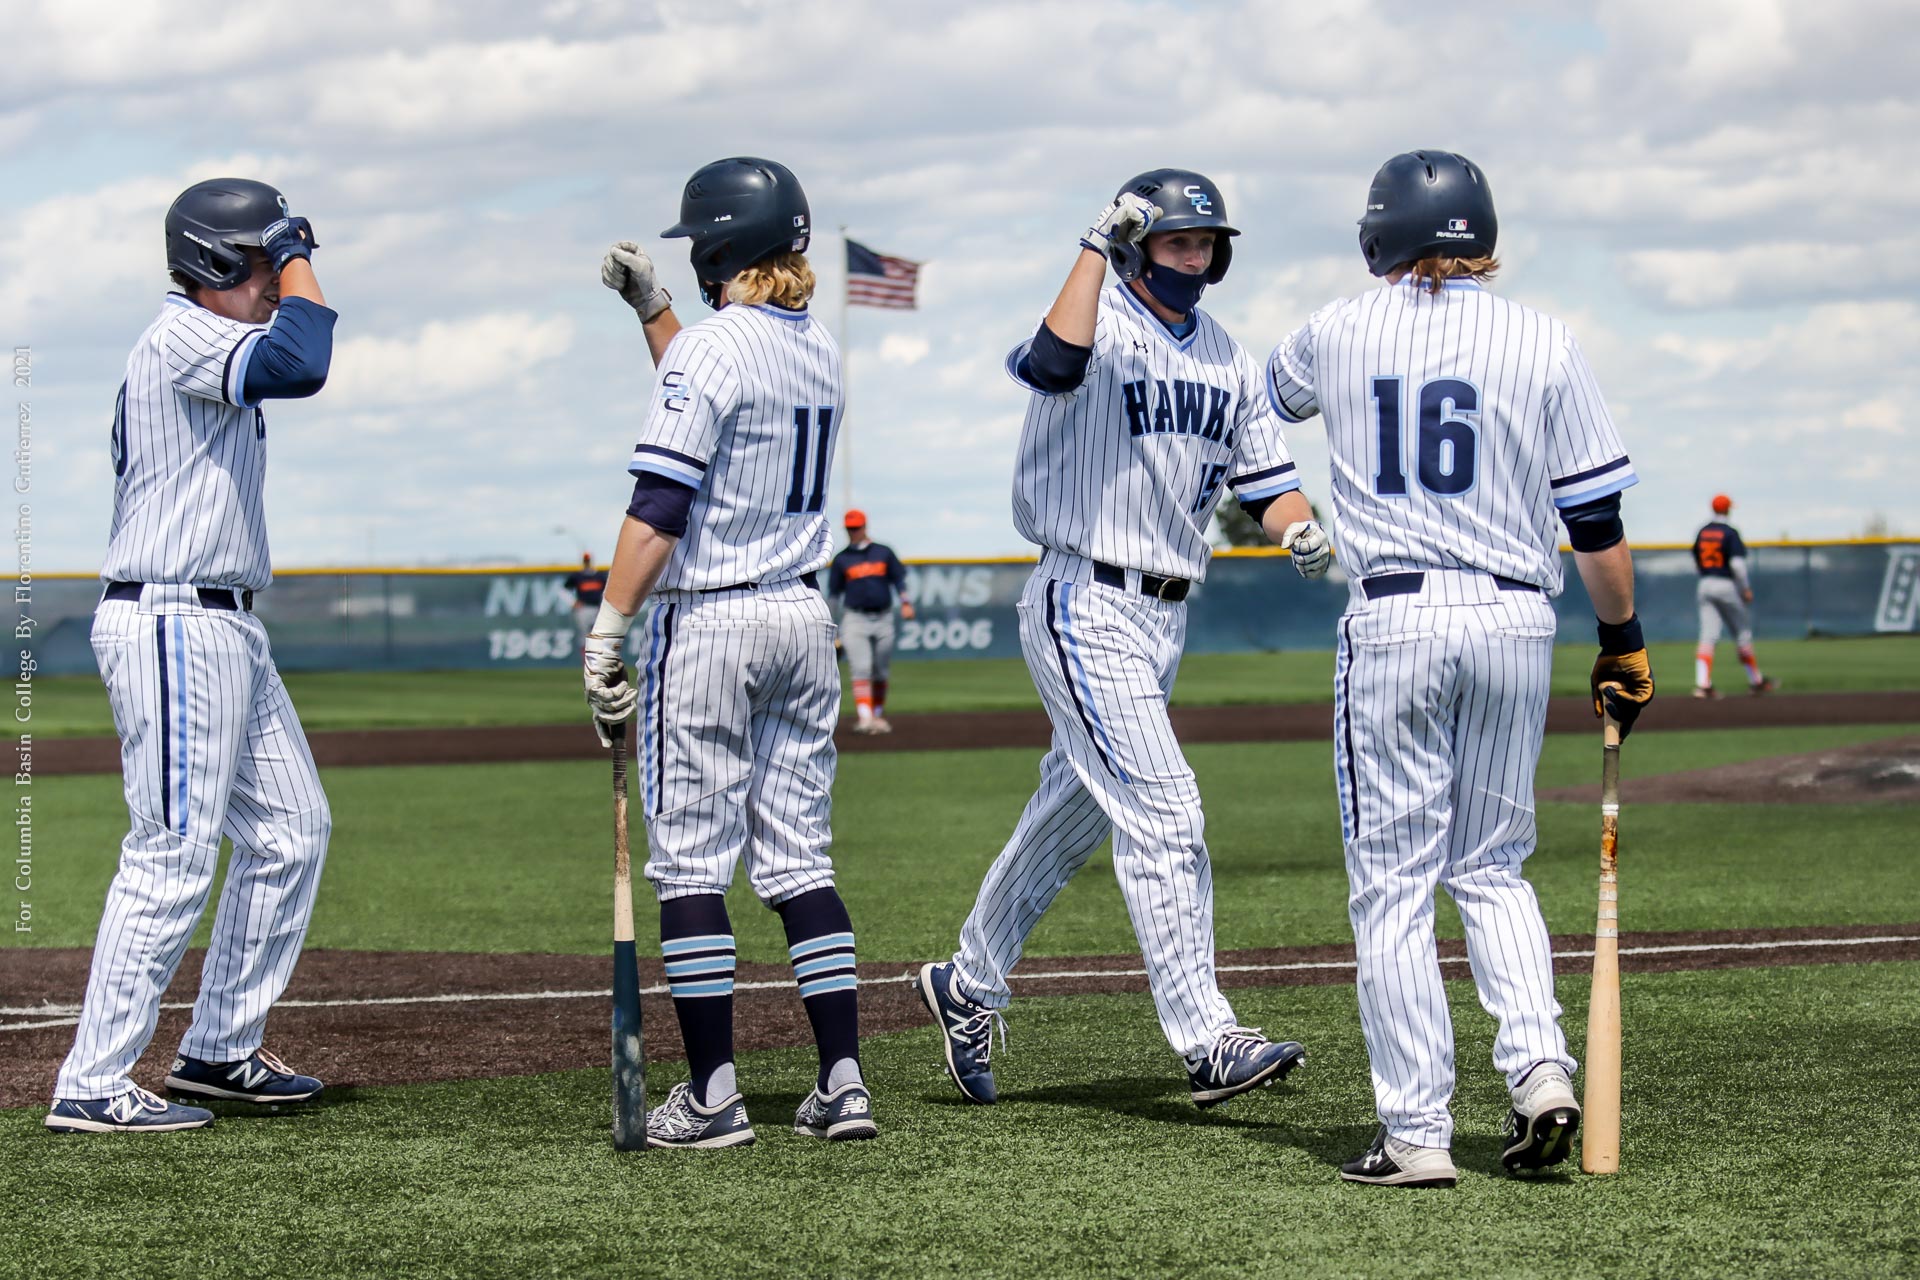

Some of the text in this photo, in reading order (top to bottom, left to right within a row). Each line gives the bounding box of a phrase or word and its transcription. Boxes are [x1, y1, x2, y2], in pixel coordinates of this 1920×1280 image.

[784, 405, 834, 518] 11
[1370, 375, 1481, 499] 16
[489, 628, 575, 661] 1963
[897, 618, 994, 651] 2006
